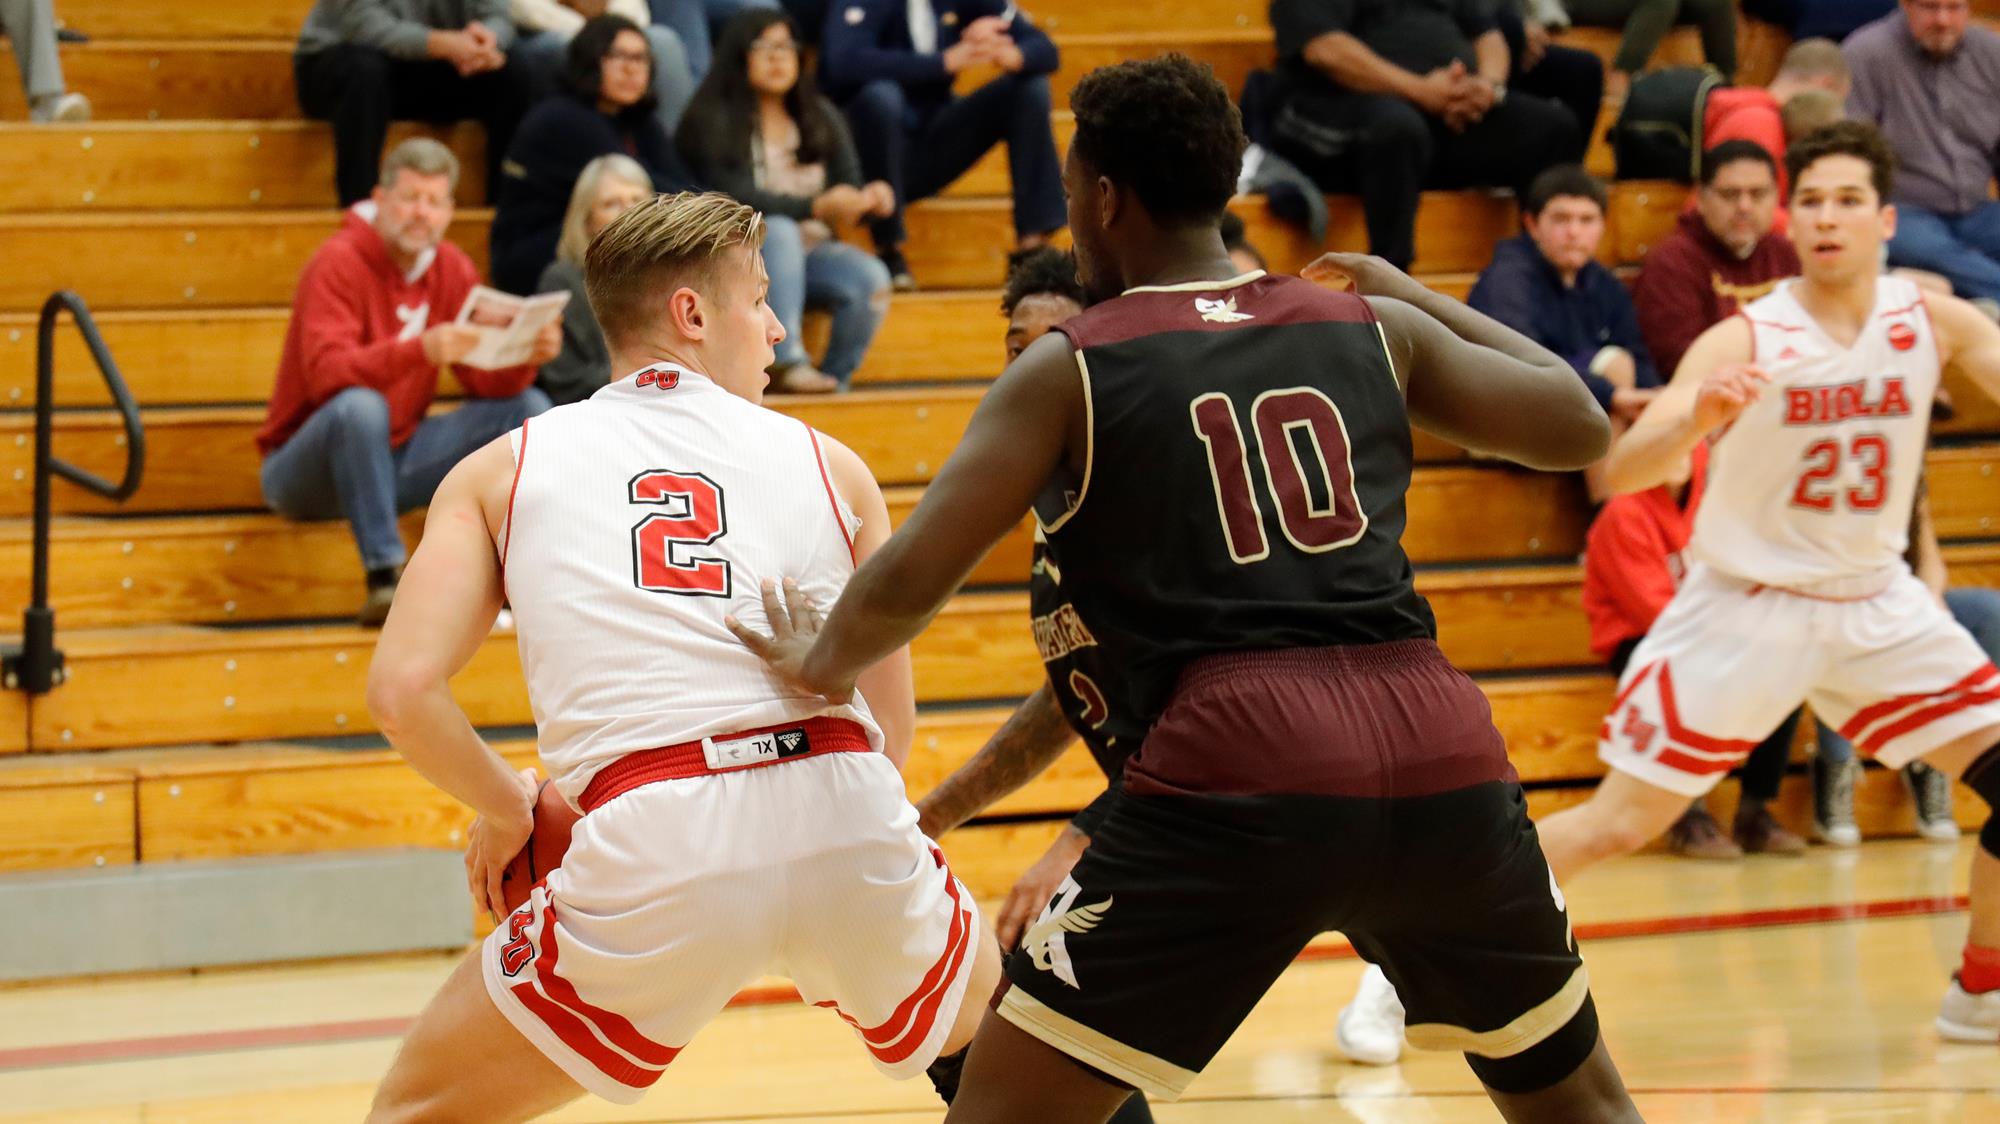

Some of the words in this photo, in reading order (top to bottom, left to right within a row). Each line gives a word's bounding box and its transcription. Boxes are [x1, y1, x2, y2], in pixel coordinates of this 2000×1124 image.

[1783, 377, 1913, 427] BIOLA
[1190, 386, 1369, 564] 10
[1788, 432, 1890, 515] 23
[628, 469, 732, 599] 2
[752, 740, 774, 754] XL
[778, 732, 803, 741] adidas
